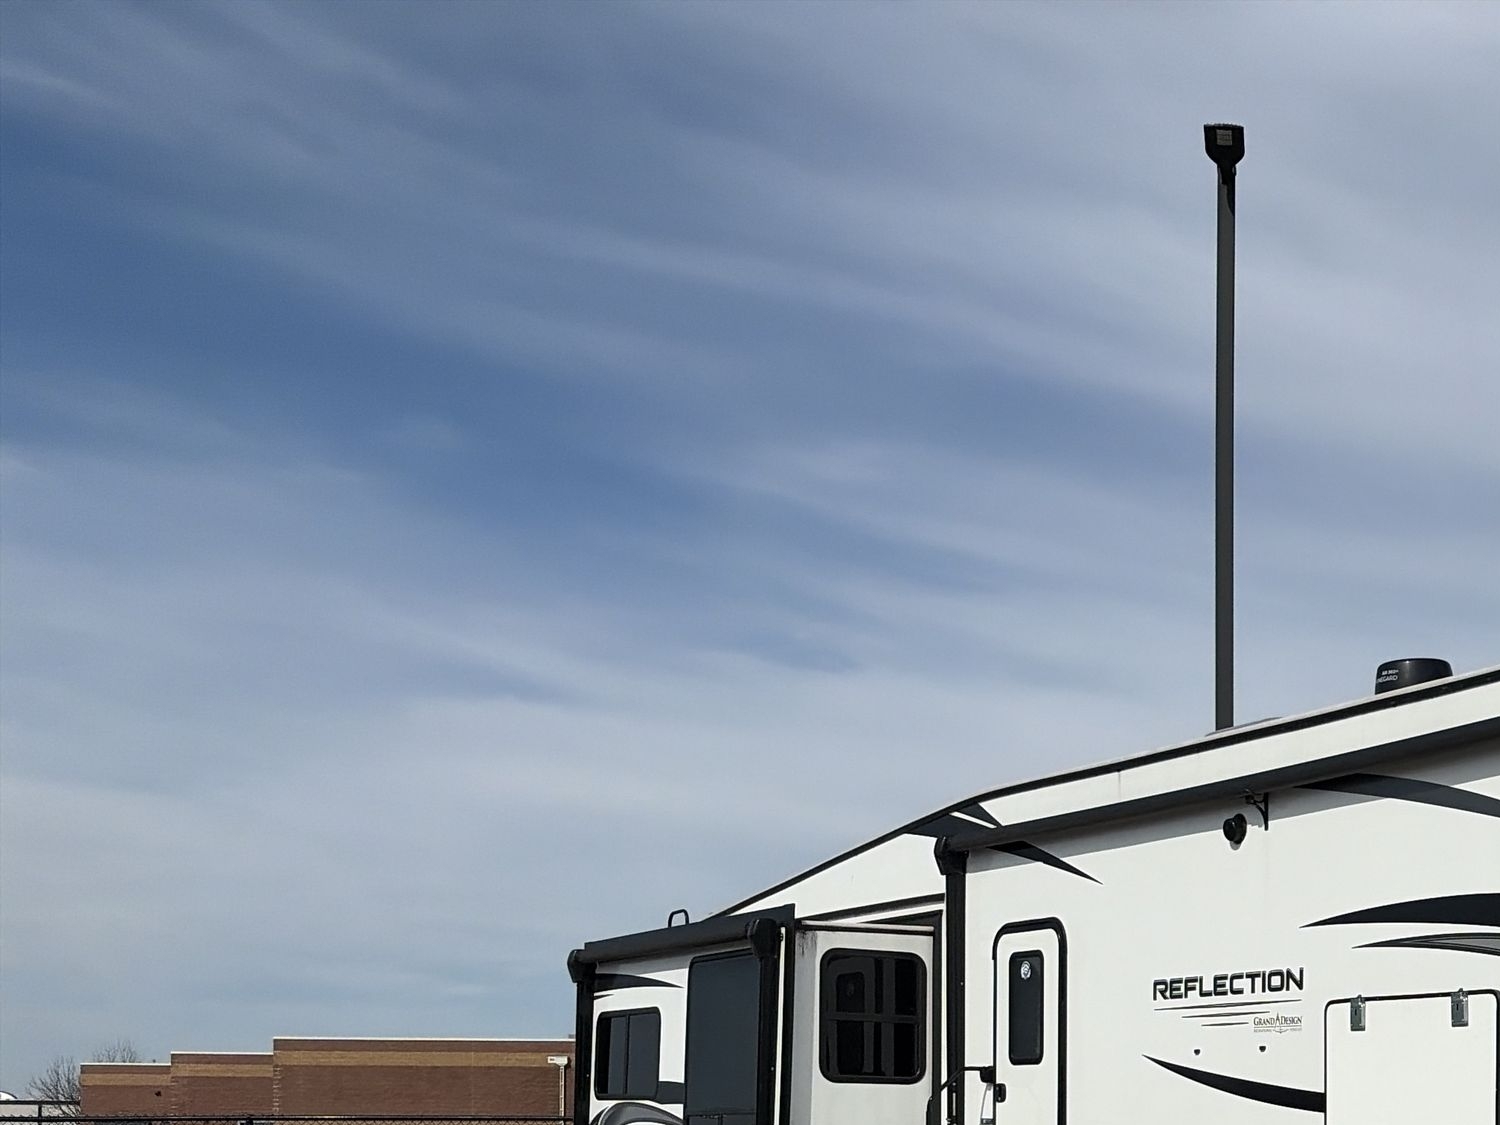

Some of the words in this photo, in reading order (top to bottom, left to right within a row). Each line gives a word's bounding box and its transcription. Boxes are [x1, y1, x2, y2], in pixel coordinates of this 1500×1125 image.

[1153, 967, 1304, 1001] REFLECTION
[1253, 1016, 1275, 1026] GRAND
[1281, 1015, 1303, 1025] DESIGN
